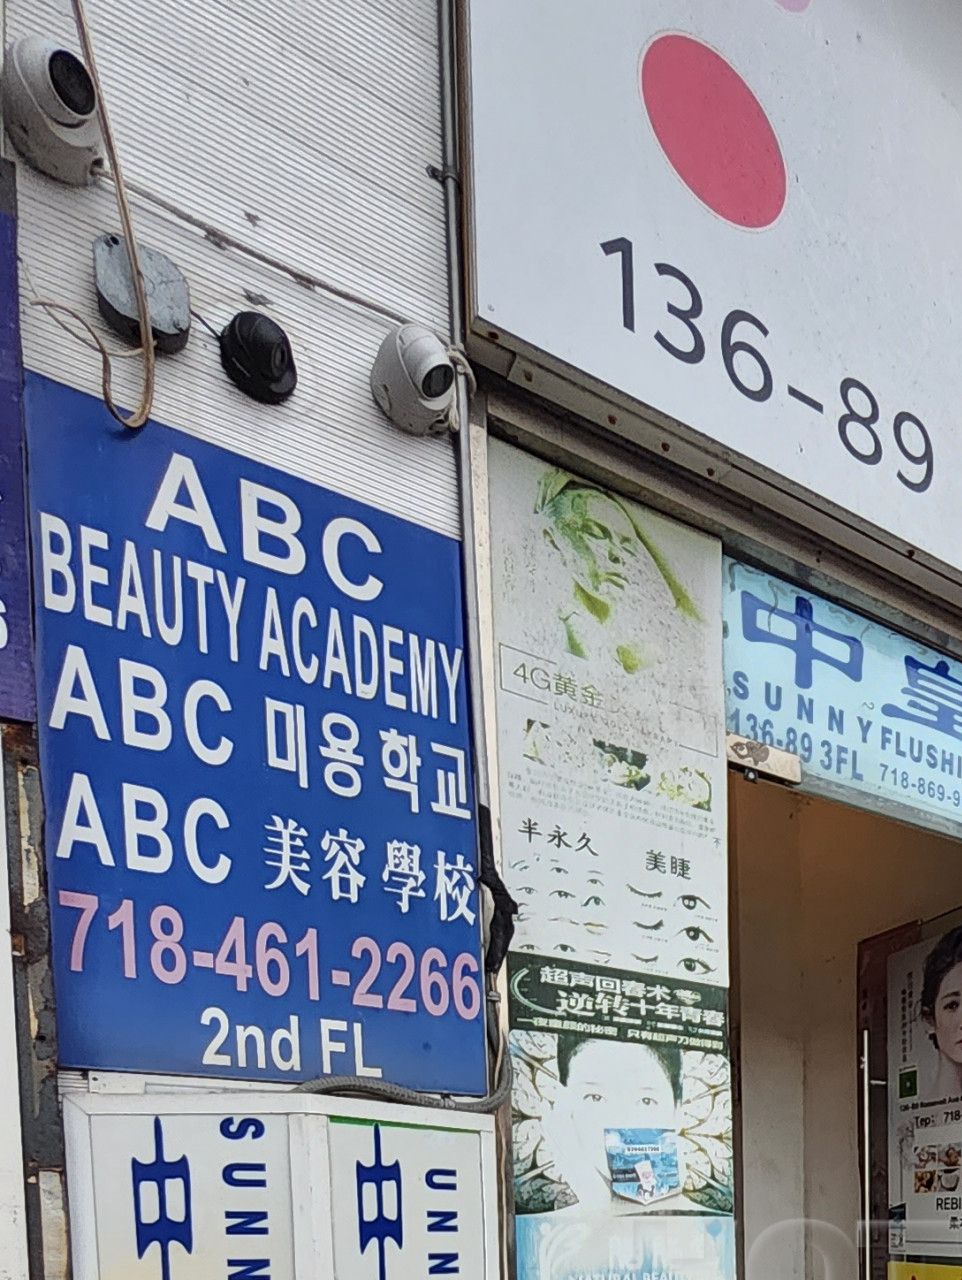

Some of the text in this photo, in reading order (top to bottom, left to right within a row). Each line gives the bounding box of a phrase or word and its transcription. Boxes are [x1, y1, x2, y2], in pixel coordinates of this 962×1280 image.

[600, 236, 934, 493] 136-89
[145, 452, 384, 602] ABC
[39, 511, 463, 724] BEAUTY ACADEMY
[49, 643, 234, 766] ABC
[732, 670, 873, 744] SUNNY
[819, 739, 865, 782] 3FL
[55, 773, 477, 925] ABC 美容學校
[518, 817, 600, 857] 半永久
[58, 890, 481, 1021] 718-461-2266
[199, 1006, 383, 1079] 2nd FL
